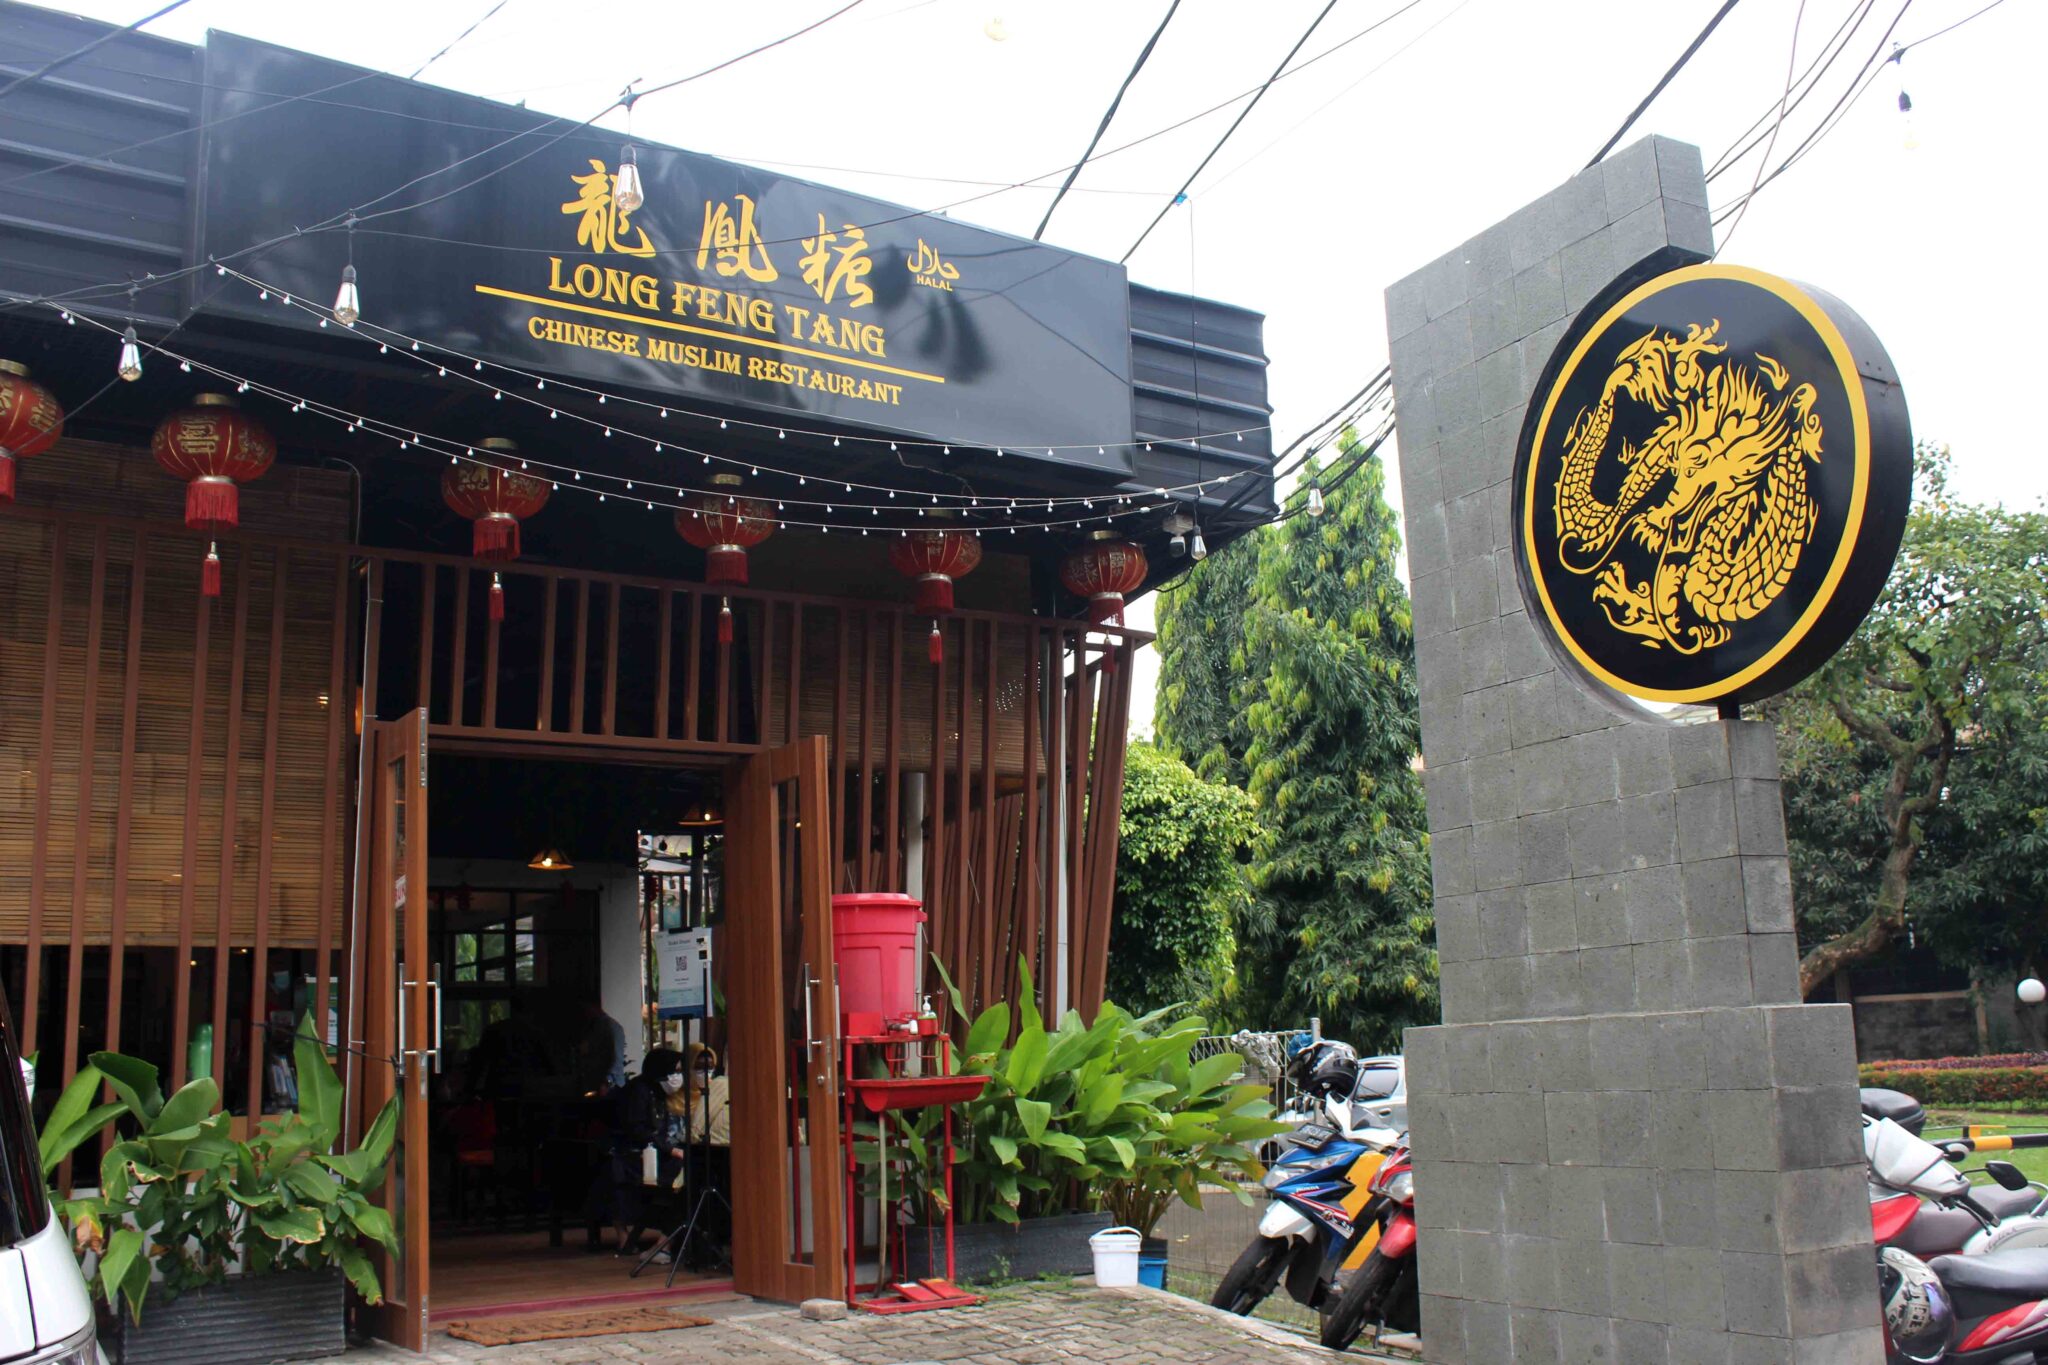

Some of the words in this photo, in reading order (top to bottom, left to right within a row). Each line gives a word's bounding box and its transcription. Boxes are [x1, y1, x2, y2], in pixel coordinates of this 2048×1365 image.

[907, 238, 960, 279] حلال
[916, 275, 953, 291] HALAL
[549, 256, 660, 311] LONG
[672, 281, 775, 333] FENG
[785, 304, 886, 358] TANG
[528, 316, 641, 357] CHINESE
[646, 337, 741, 376] MUSLIM
[748, 356, 902, 405] RESTAURANT
